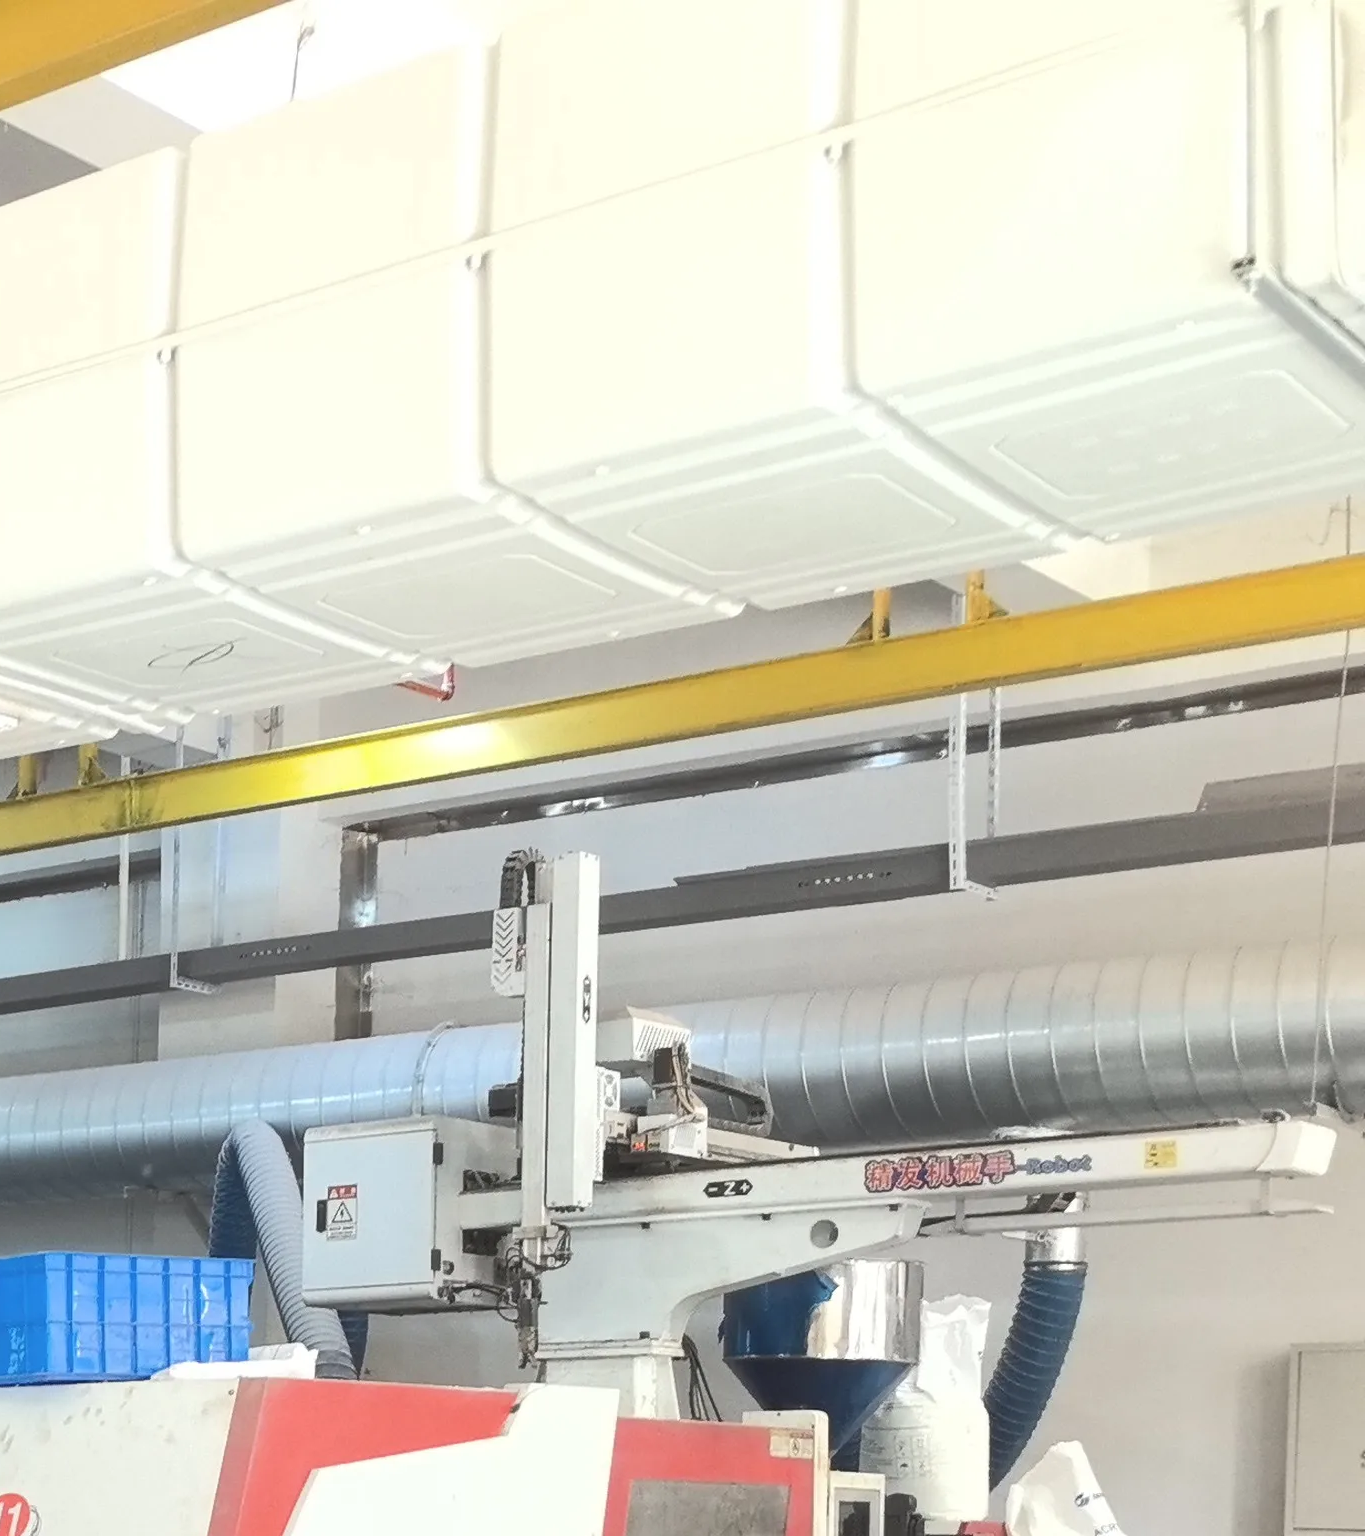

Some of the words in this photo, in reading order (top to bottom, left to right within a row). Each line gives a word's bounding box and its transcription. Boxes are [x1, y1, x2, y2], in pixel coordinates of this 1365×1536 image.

[865, 1150, 1017, 1193] 精发机械手
